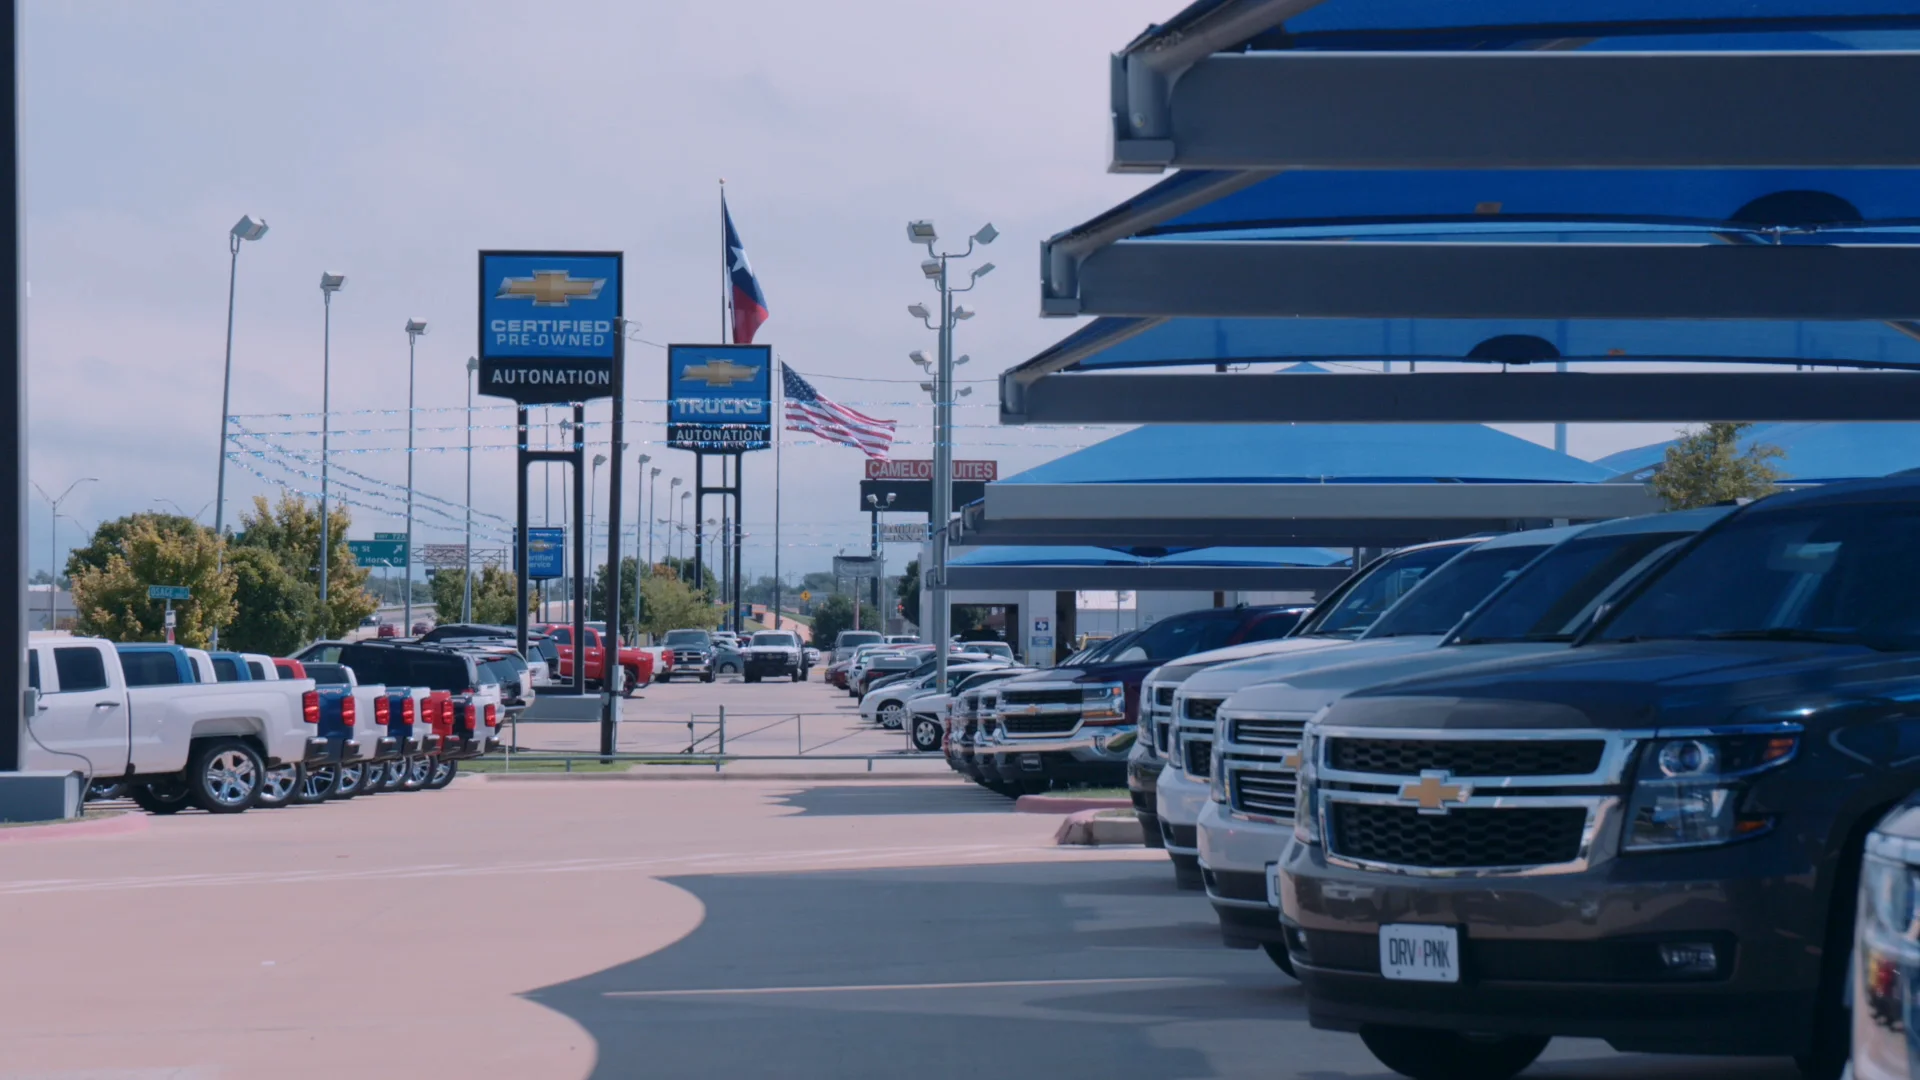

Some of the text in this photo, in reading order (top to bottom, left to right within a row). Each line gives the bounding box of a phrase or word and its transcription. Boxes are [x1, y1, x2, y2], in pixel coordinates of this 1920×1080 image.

[491, 320, 610, 333] CERTIFIED
[496, 333, 605, 346] PRE-OWNED
[492, 369, 609, 385] AUTONATION
[676, 398, 761, 414] TRUCKS
[676, 430, 763, 441] AUTONATION
[869, 461, 994, 478] CAMELOT UITES
[361, 544, 371, 552] St
[393, 556, 404, 564] Dr
[528, 554, 554, 562] ertified
[1389, 938, 1451, 968] DRV PNK
